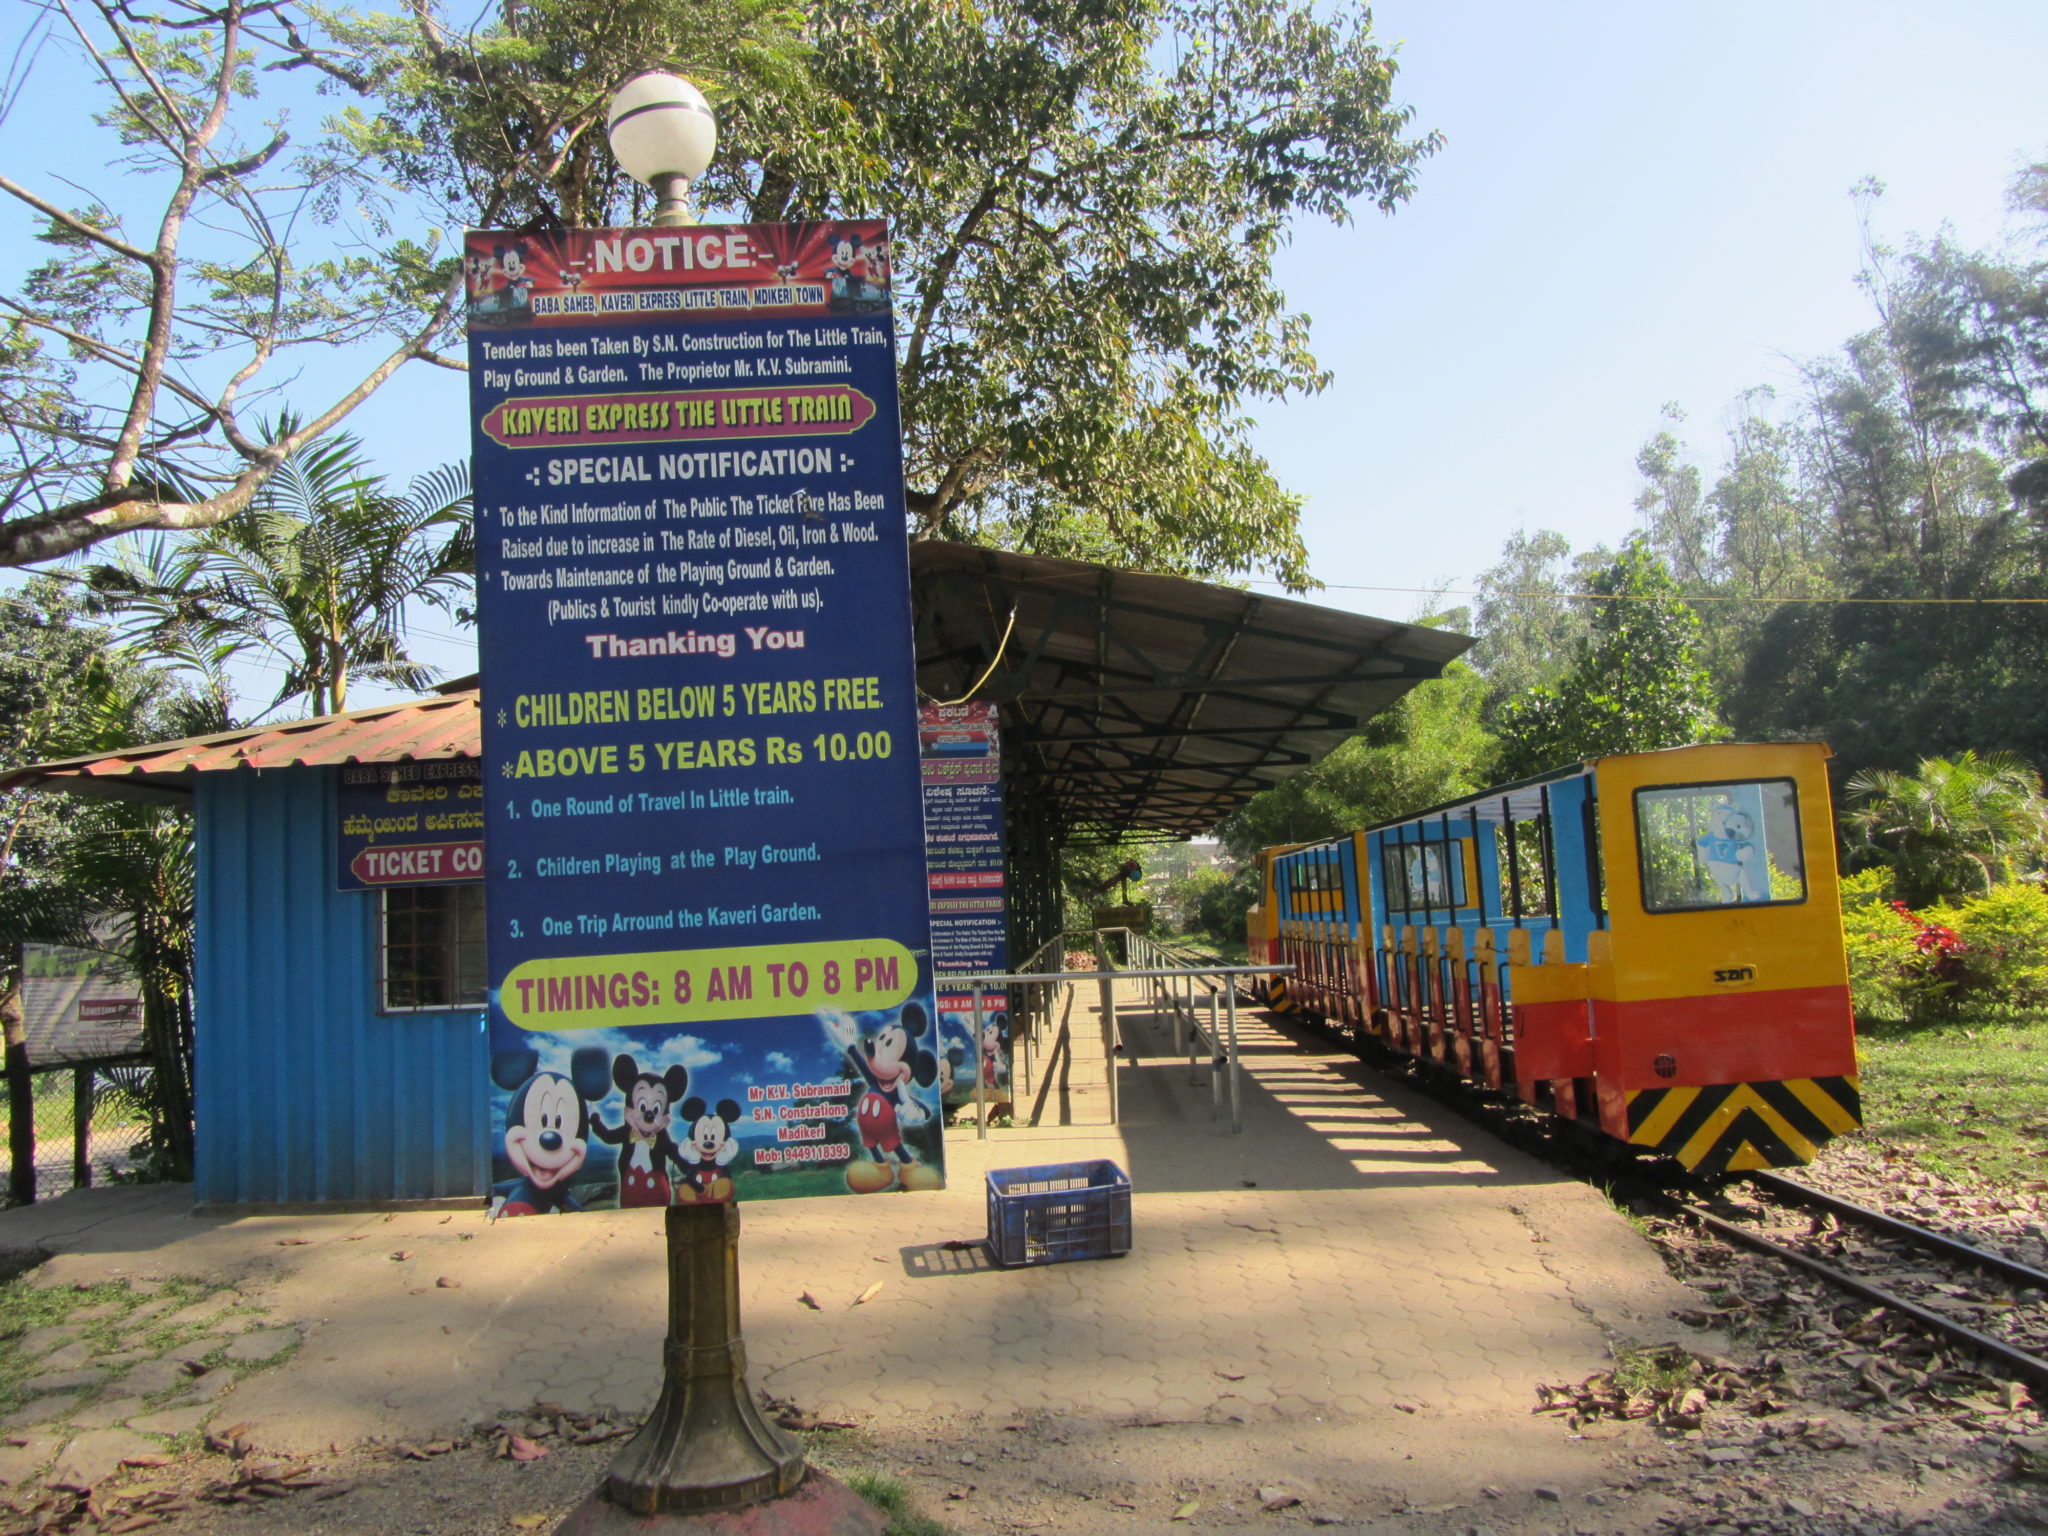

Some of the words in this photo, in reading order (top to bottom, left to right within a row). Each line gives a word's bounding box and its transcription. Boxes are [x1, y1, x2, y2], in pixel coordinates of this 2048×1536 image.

[534, 297, 560, 314] BABA
[601, 294, 636, 311] KAVERI
[639, 292, 680, 310] EXPRESS
[684, 291, 716, 307] LITTLE
[754, 288, 792, 304] MDIKERI
[796, 287, 824, 303] TOWN
[482, 340, 528, 360] Tender
[529, 340, 554, 358] has
[556, 338, 588, 357] been
[590, 336, 630, 356] Taken
[632, 335, 650, 358] By
[652, 334, 679, 353] S.N.
[681, 331, 764, 352] Construction
[766, 330, 785, 349] for
[786, 329, 812, 348] The
[814, 327, 848, 347] Little
[850, 326, 887, 348] Train,
[483, 369, 512, 392] Play
[514, 367, 561, 387] Ground
[564, 366, 575, 385] &
[577, 364, 628, 384] Garden.
[638, 362, 664, 381] The
[667, 360, 731, 384] Proprietor
[734, 359, 754, 377] Mr.
[756, 357, 782, 377] K.V.
[784, 355, 852, 376] Subramini.
[502, 406, 579, 436] KAVERI
[586, 401, 669, 430] EXPRESS
[676, 399, 716, 428] THE
[721, 396, 782, 425] LITTLE
[788, 394, 853, 422] TRAIN
[547, 455, 652, 486] SPECIAL
[658, 447, 832, 481] NOTIFICATION
[499, 506, 515, 527] To
[517, 505, 538, 527] the
[540, 503, 569, 525] Kind
[571, 500, 642, 524] Information
[644, 498, 657, 521] of
[663, 498, 688, 519] The
[690, 496, 728, 518] Public
[729, 495, 754, 516] The
[756, 493, 795, 515] Ticket
[827, 491, 852, 512] Has
[853, 490, 885, 511] Been
[501, 536, 543, 559] Raised
[545, 535, 569, 557] due
[571, 536, 585, 556] to
[587, 534, 640, 555] increase
[642, 531, 655, 552] in
[660, 530, 685, 551] The
[687, 529, 716, 550] Rate
[718, 527, 731, 549] of
[734, 525, 776, 551] Diesel,
[778, 524, 800, 550] Oil,
[801, 524, 827, 545] Iron
[829, 522, 840, 544] &
[841, 521, 879, 543] Wood.
[500, 568, 554, 591] Towards
[555, 566, 635, 588] Maintenance
[637, 562, 650, 585] of
[656, 562, 677, 584] the
[679, 560, 725, 587] Playing
[727, 557, 771, 580] Ground
[774, 556, 785, 578] &
[786, 555, 835, 578] Garden.
[548, 598, 597, 626] (Publics
[600, 596, 610, 619] &
[612, 595, 656, 618] Tourist
[662, 593, 700, 619] kindly
[702, 591, 769, 617] Co-operate
[771, 588, 798, 610] with
[585, 631, 736, 660] Thanking
[744, 626, 805, 650] You
[515, 689, 630, 729] CHILDREN
[637, 684, 716, 721] BELOW
[722, 683, 736, 717] 5
[741, 679, 817, 715] YEARS
[628, 743, 646, 773] 5
[654, 737, 757, 770] YEARS
[766, 736, 803, 765] Rs
[813, 730, 892, 762] 10.00
[381, 765, 421, 782] SHEB
[506, 800, 521, 820] 1.
[531, 798, 562, 818] One
[566, 794, 614, 816] Round
[618, 793, 634, 814] of
[637, 790, 686, 812] Travel
[709, 787, 750, 808] Little
[753, 785, 794, 806] train.
[365, 849, 443, 877] TICKET
[452, 847, 482, 872] CO
[507, 859, 522, 879] 2.
[536, 855, 601, 877] Children
[605, 851, 662, 877] Playing
[670, 850, 686, 870] at
[689, 848, 716, 868] the
[724, 846, 757, 870] Play
[761, 841, 821, 864] Ground.
[509, 918, 524, 939] 3.
[542, 916, 573, 937] One
[576, 913, 608, 938] Trip
[611, 909, 674, 933] Arround
[677, 908, 704, 929] the
[707, 904, 757, 927] Kaveri
[760, 902, 821, 923] Garden.
[937, 960, 972, 968] Thanking
[516, 970, 660, 1014] TIMINGS:
[674, 969, 692, 1004] 8
[706, 965, 753, 1004] AM
[766, 961, 809, 997] TO
[823, 960, 841, 995] 8
[855, 956, 899, 993] PM
[961, 1000, 972, 1009] AM
[994, 998, 1006, 1007] PM
[748, 1086, 764, 1101] Mr
[767, 1084, 789, 1099] K.V.
[792, 1079, 850, 1098] Subramani
[753, 1106, 776, 1121] S.N.
[780, 1102, 848, 1119] Constrations
[778, 1123, 825, 1141] Madikeri
[755, 1149, 782, 1164] Mob:
[784, 1144, 850, 1160] 9449118393
